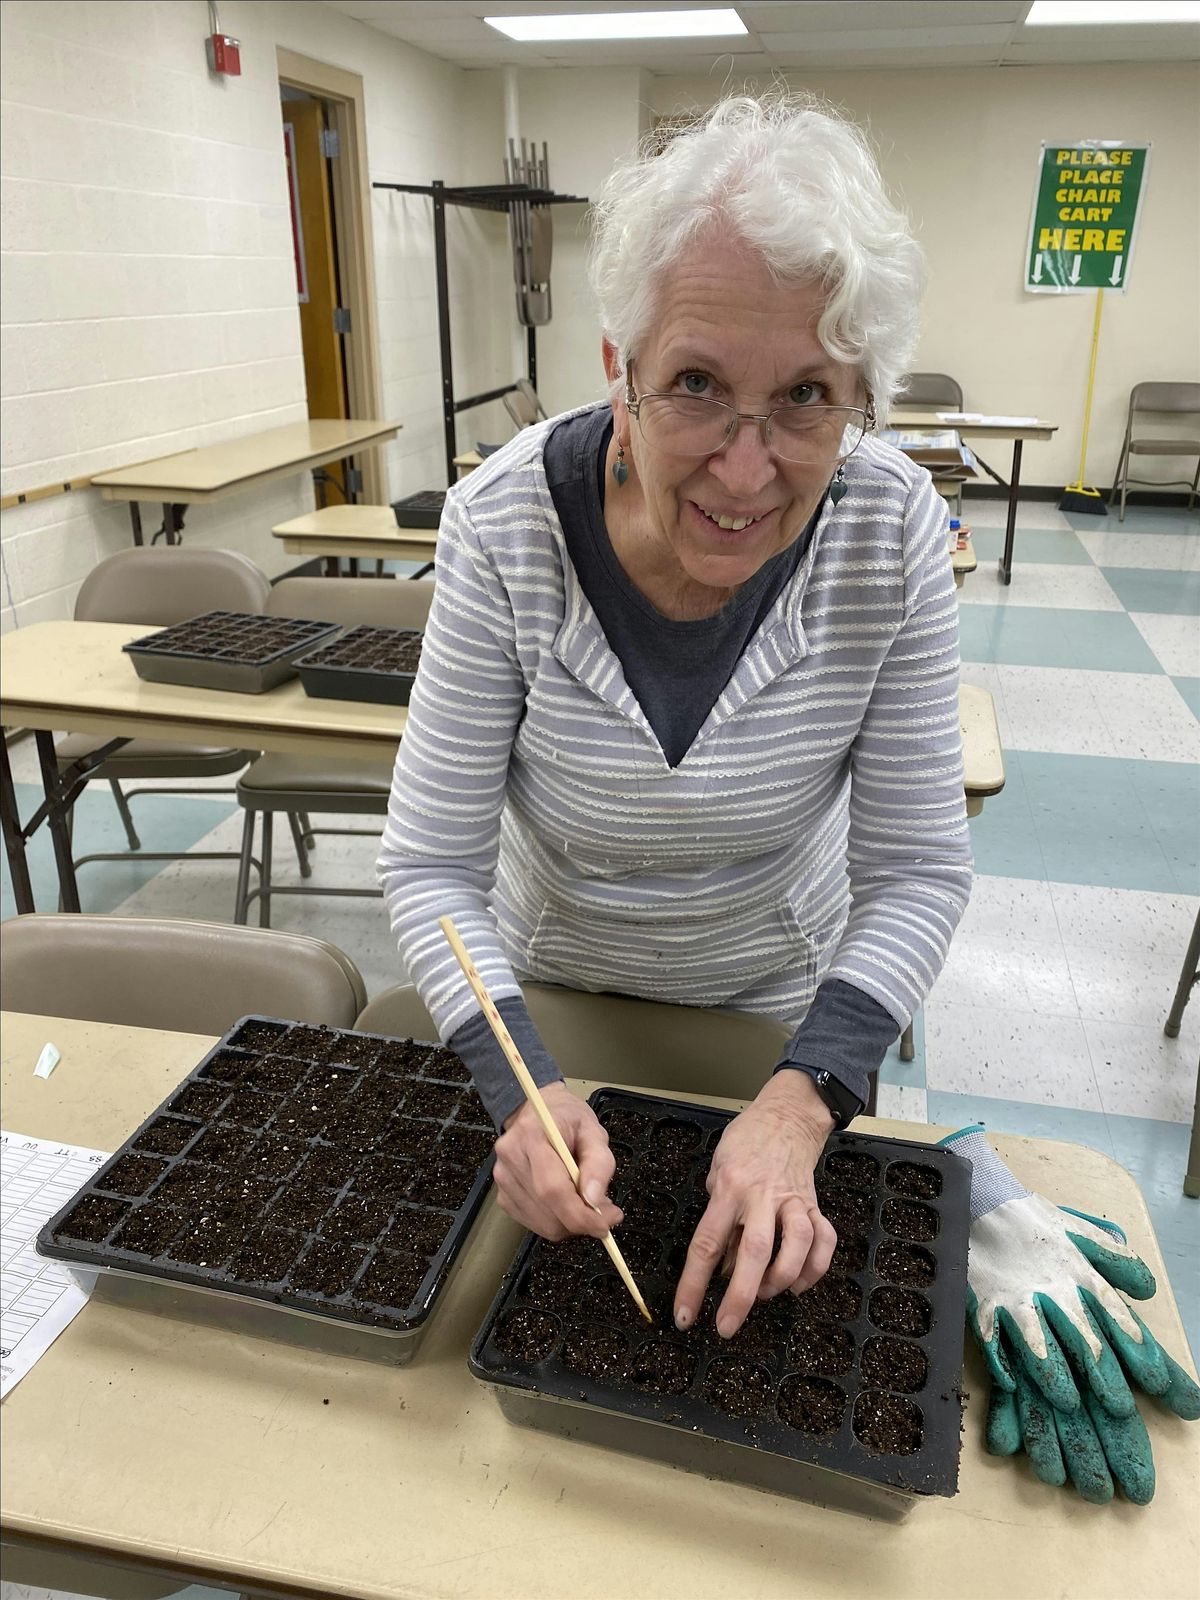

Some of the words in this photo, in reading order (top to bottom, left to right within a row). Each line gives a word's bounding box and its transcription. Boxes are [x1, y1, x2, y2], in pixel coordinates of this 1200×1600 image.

[1056, 150, 1134, 166] PLEASE
[1059, 169, 1125, 184] PLACE
[1055, 188, 1122, 203] CHAIR
[1058, 207, 1113, 222] CART
[1038, 228, 1127, 251] HERE
